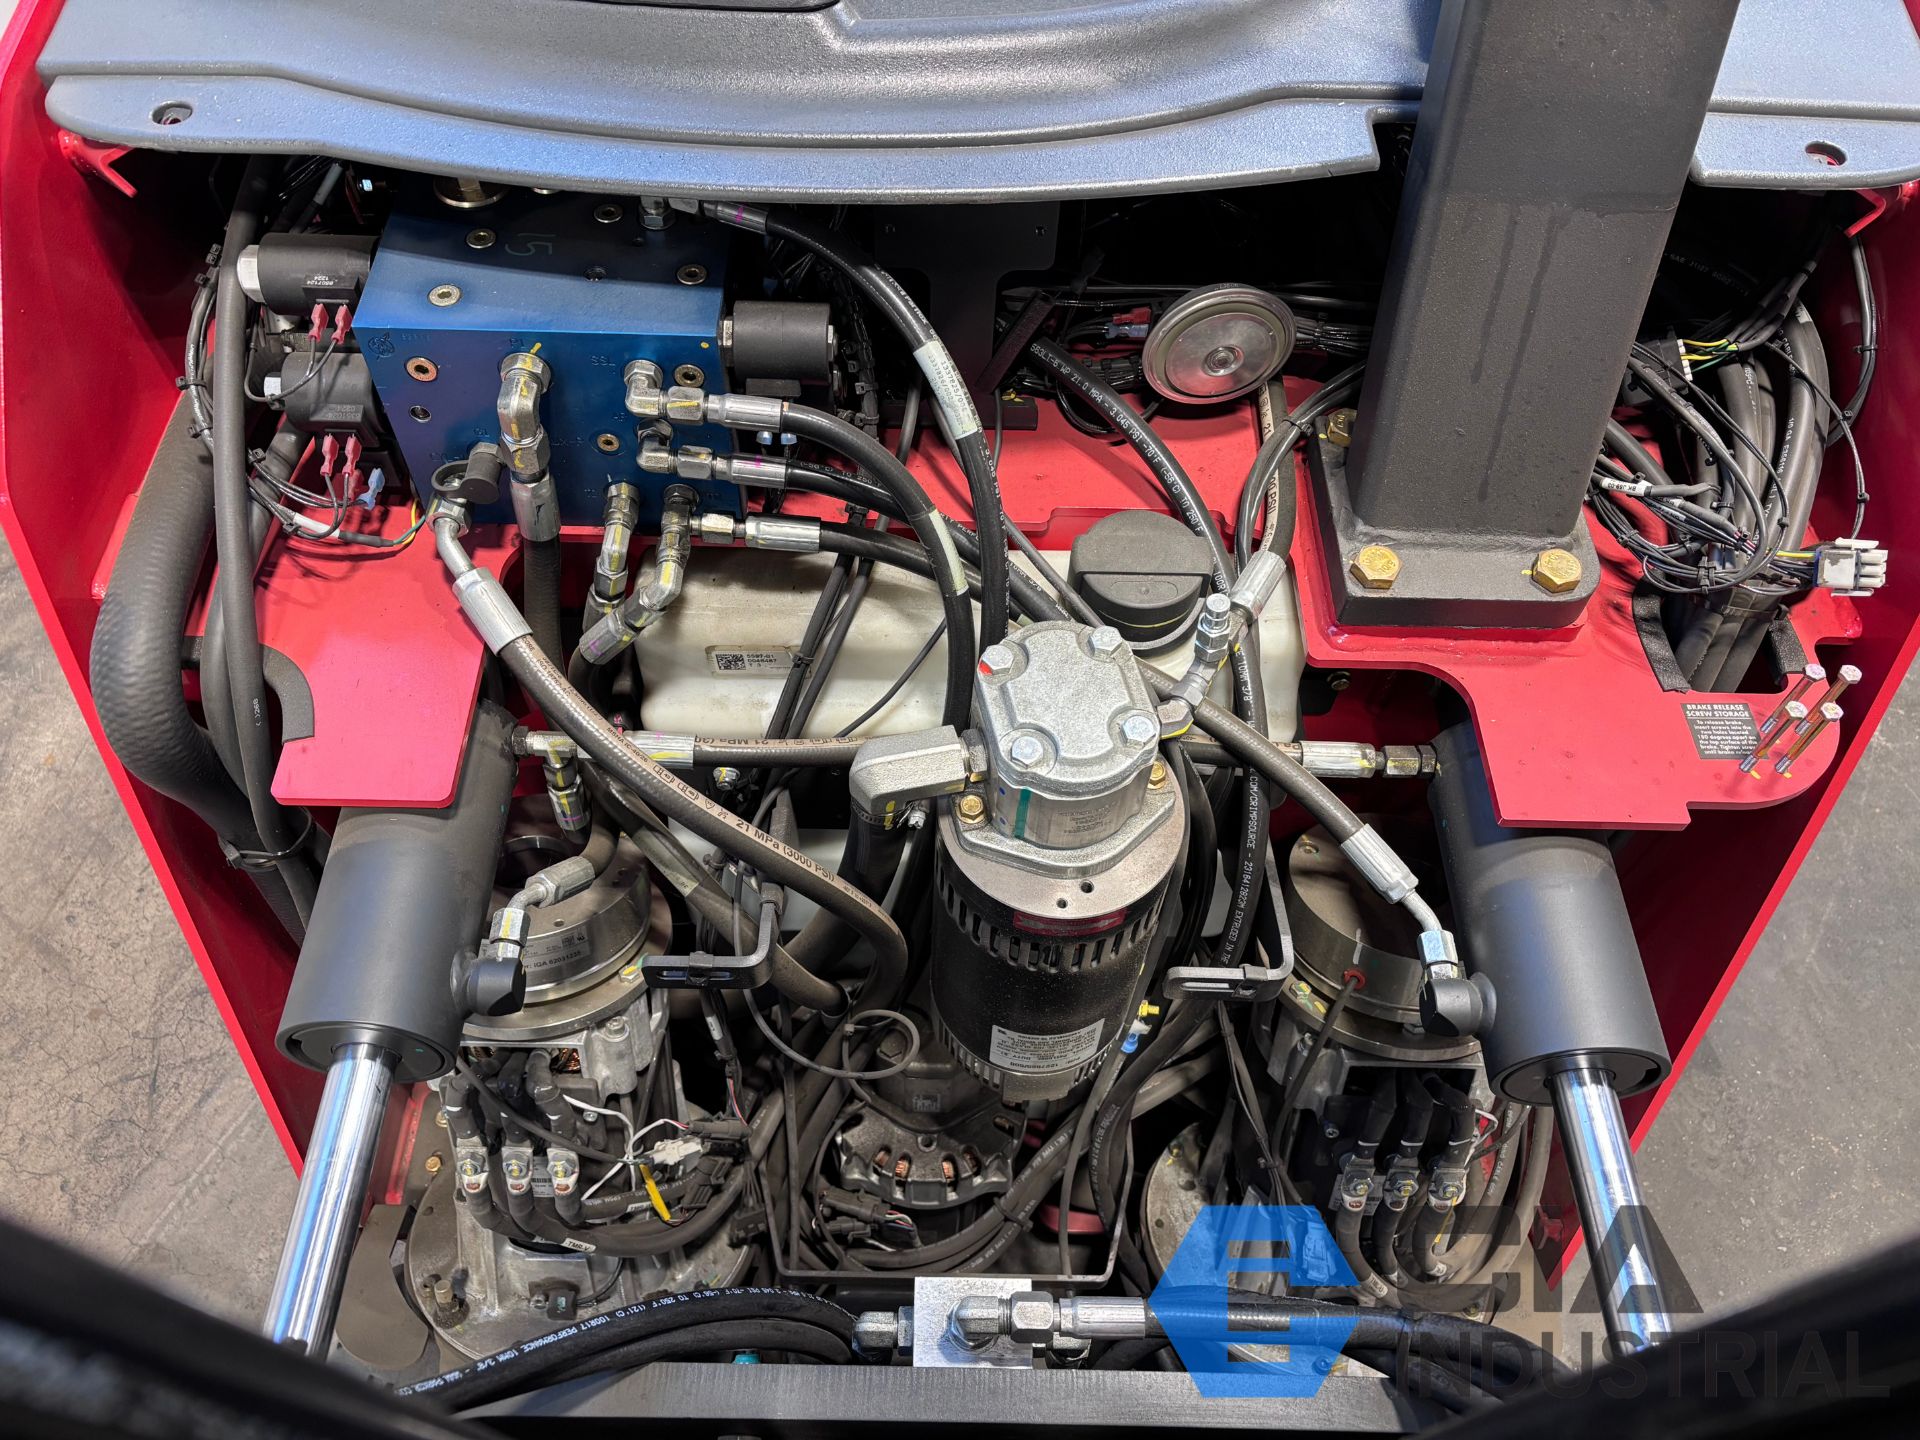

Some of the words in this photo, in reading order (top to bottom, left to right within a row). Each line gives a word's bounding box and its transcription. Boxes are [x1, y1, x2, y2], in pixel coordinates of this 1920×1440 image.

[1129, 427, 1143, 443] PSI
[1181, 497, 1190, 508] TO
[736, 819, 750, 832] 21
[754, 827, 780, 850] MPa
[782, 845, 812, 868] (3000
[814, 862, 835, 883] PSI)
[677, 1294, 691, 1302] TO
[580, 1314, 610, 1329] 100R17
[520, 1326, 578, 1353] PERFORMANCE
